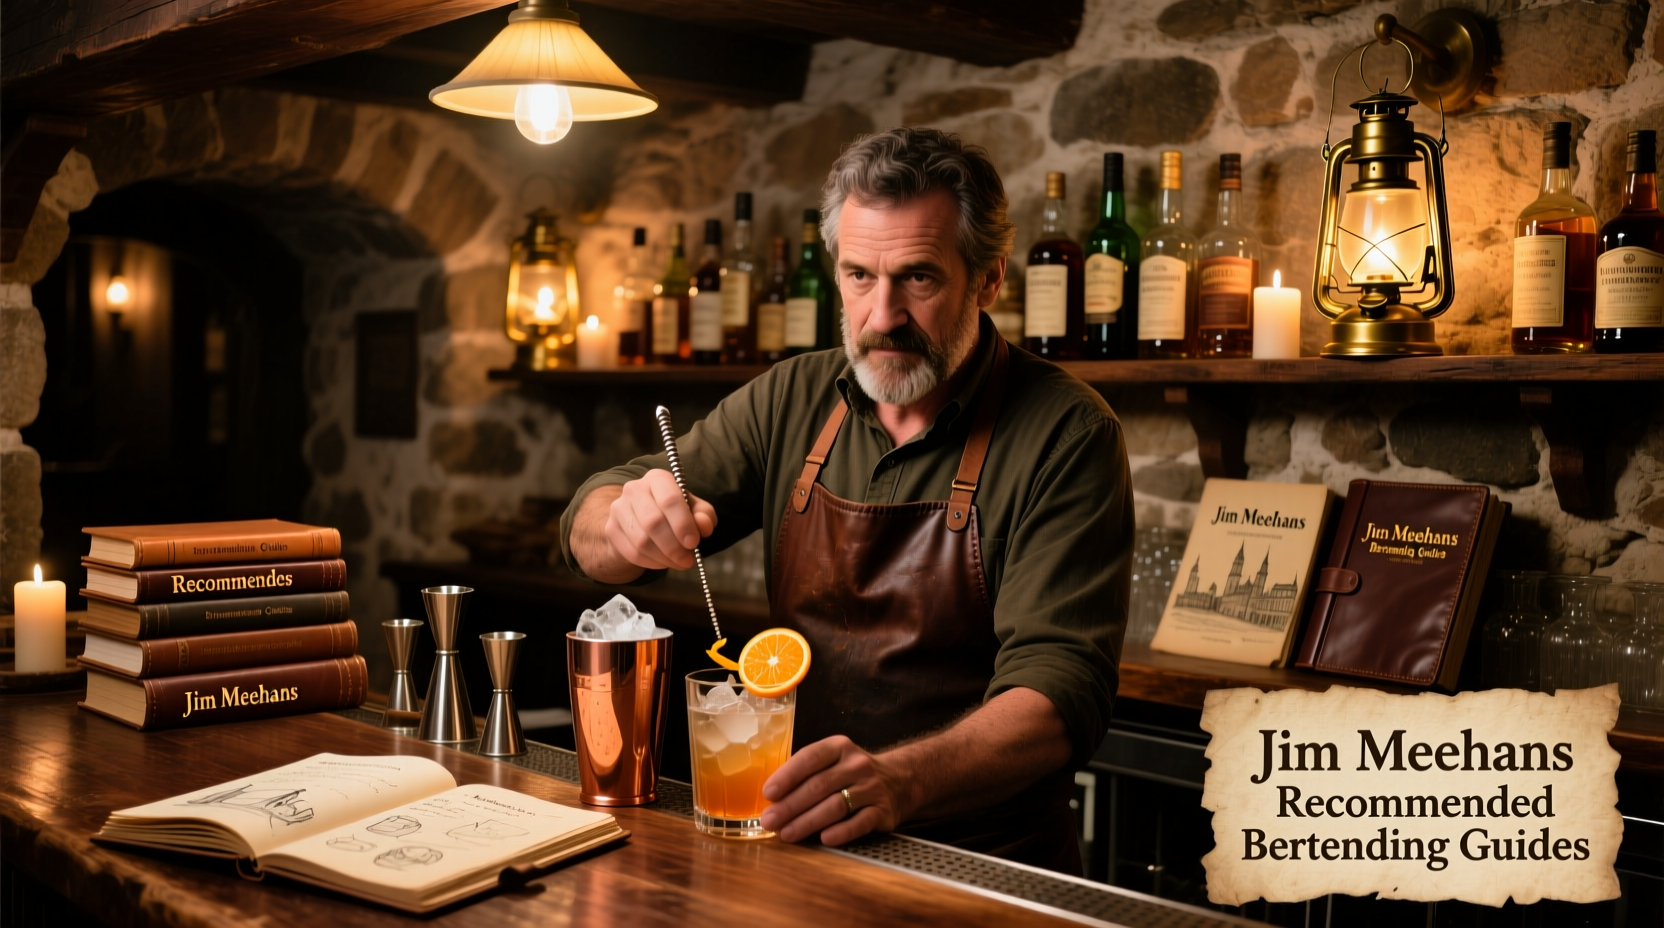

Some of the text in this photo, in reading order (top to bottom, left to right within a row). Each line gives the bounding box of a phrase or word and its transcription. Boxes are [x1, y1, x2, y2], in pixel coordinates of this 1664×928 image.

[1211, 505, 1306, 529] Jim Meehans
[1361, 522, 1459, 546] Jim Meehans
[182, 684, 298, 718] Jim Meehans
[1250, 728, 1574, 784] Jim Meehans
[1276, 784, 1556, 818] Recommended
[1241, 827, 1590, 872] Bertending Guides
